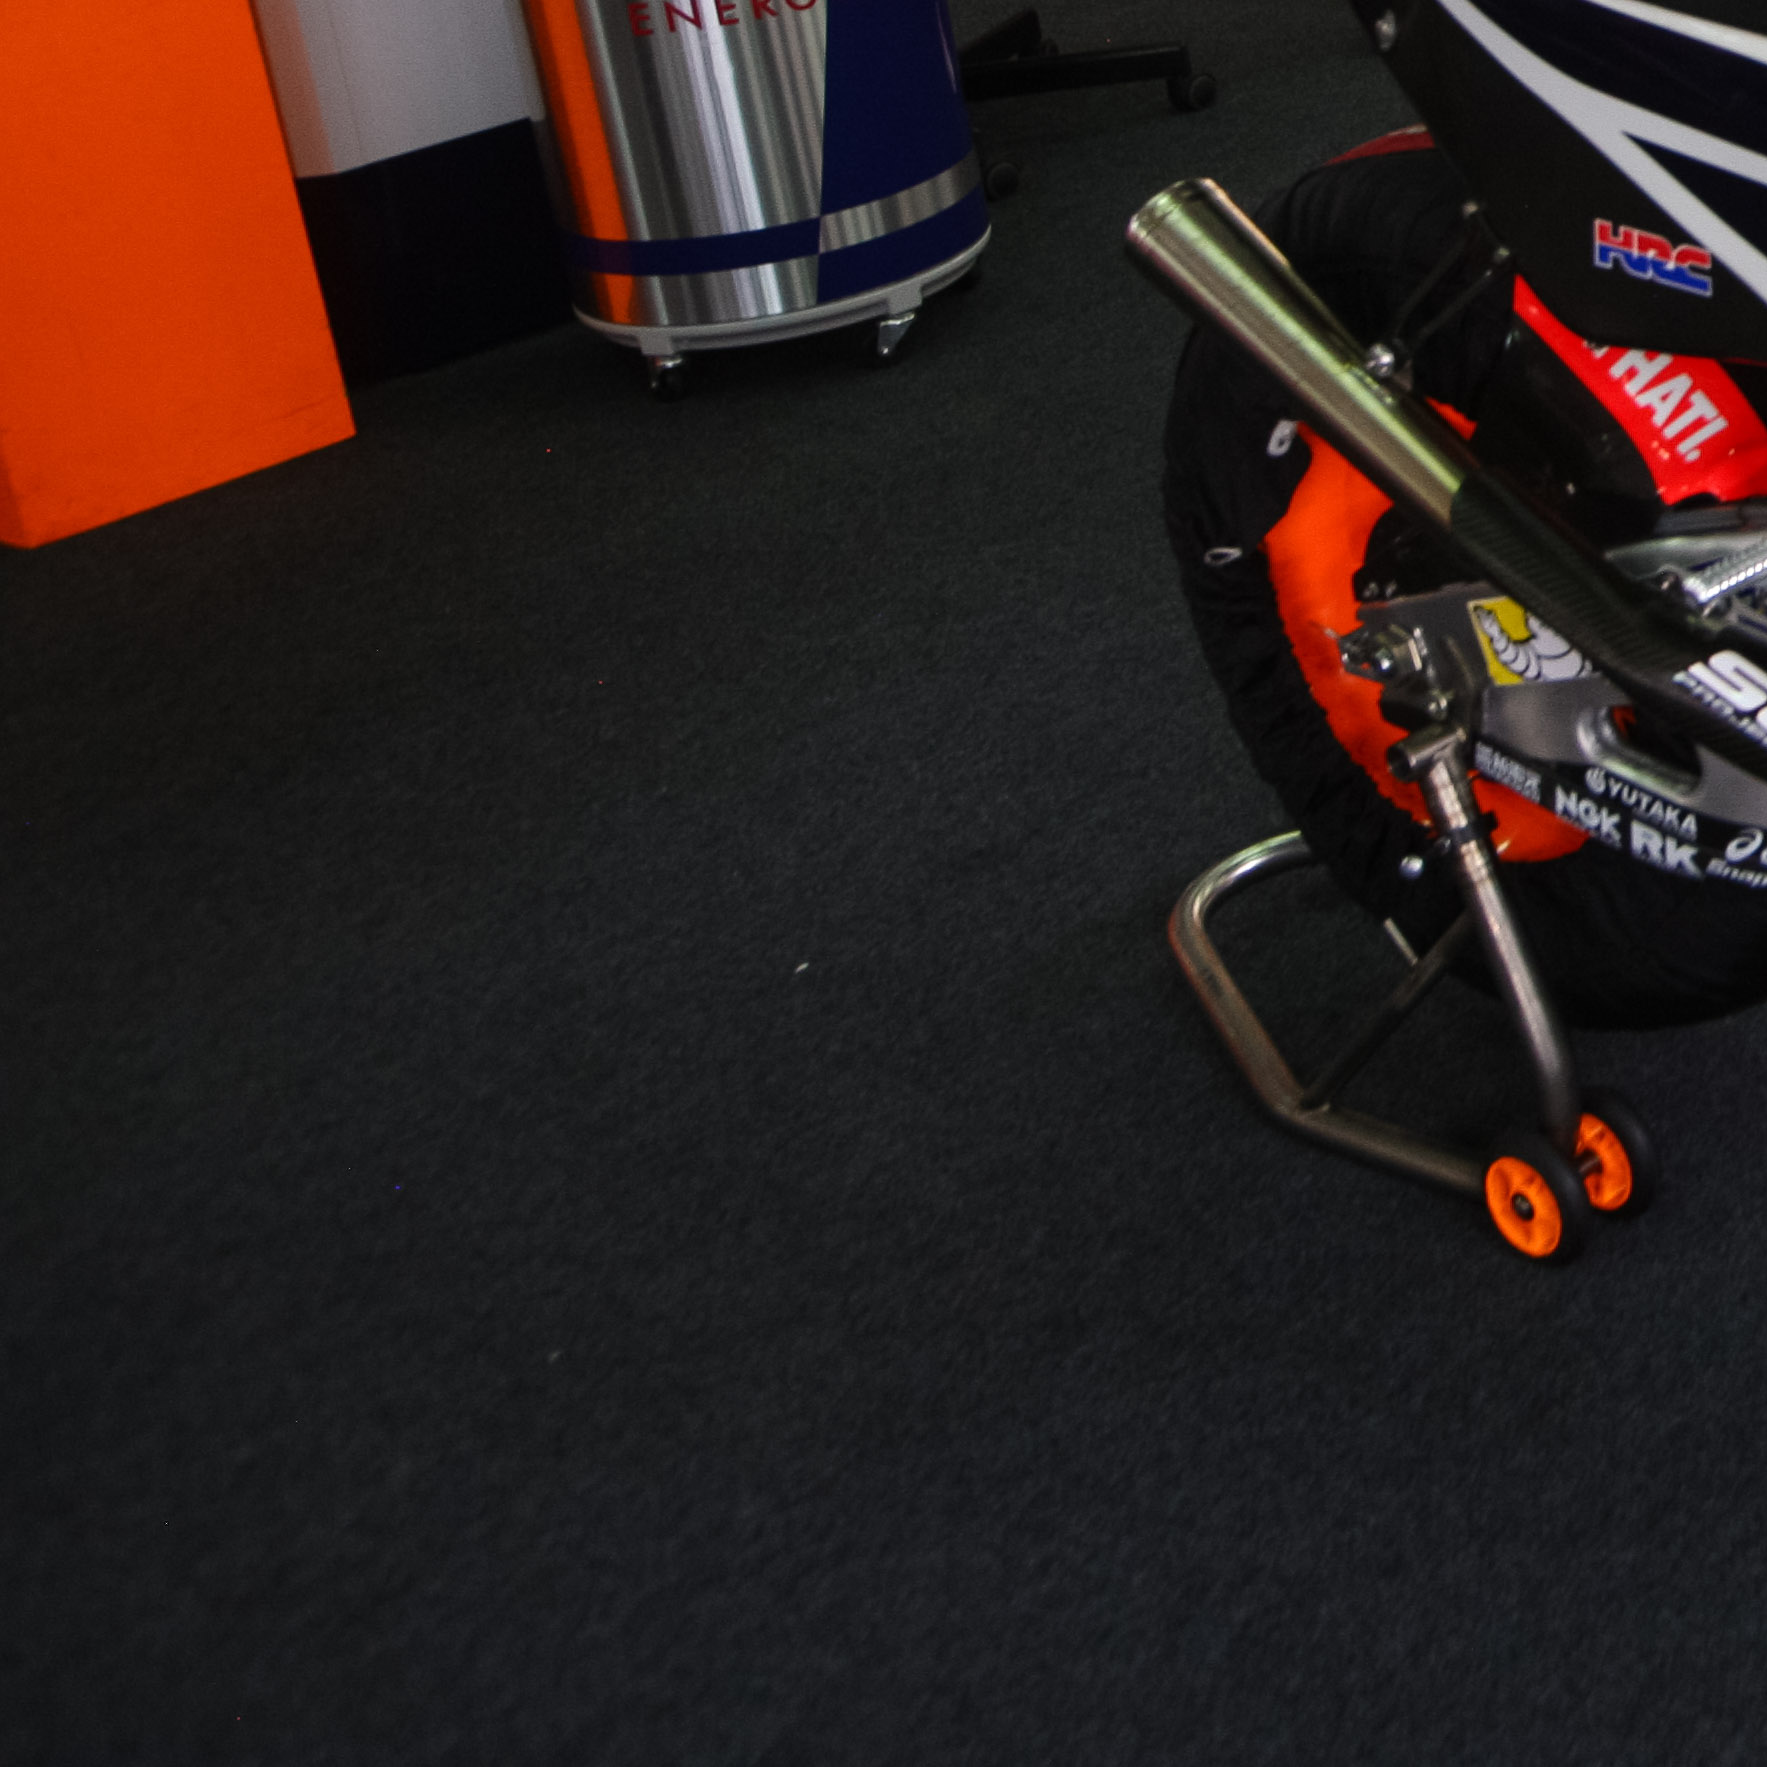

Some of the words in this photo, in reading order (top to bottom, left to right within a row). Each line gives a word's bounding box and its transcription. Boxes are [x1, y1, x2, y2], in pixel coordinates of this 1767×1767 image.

[1593, 217, 1713, 298] HRC
[1555, 786, 1621, 840] NGK
[1606, 776, 1699, 841] YUTAKA
[1630, 819, 1702, 879] RK
